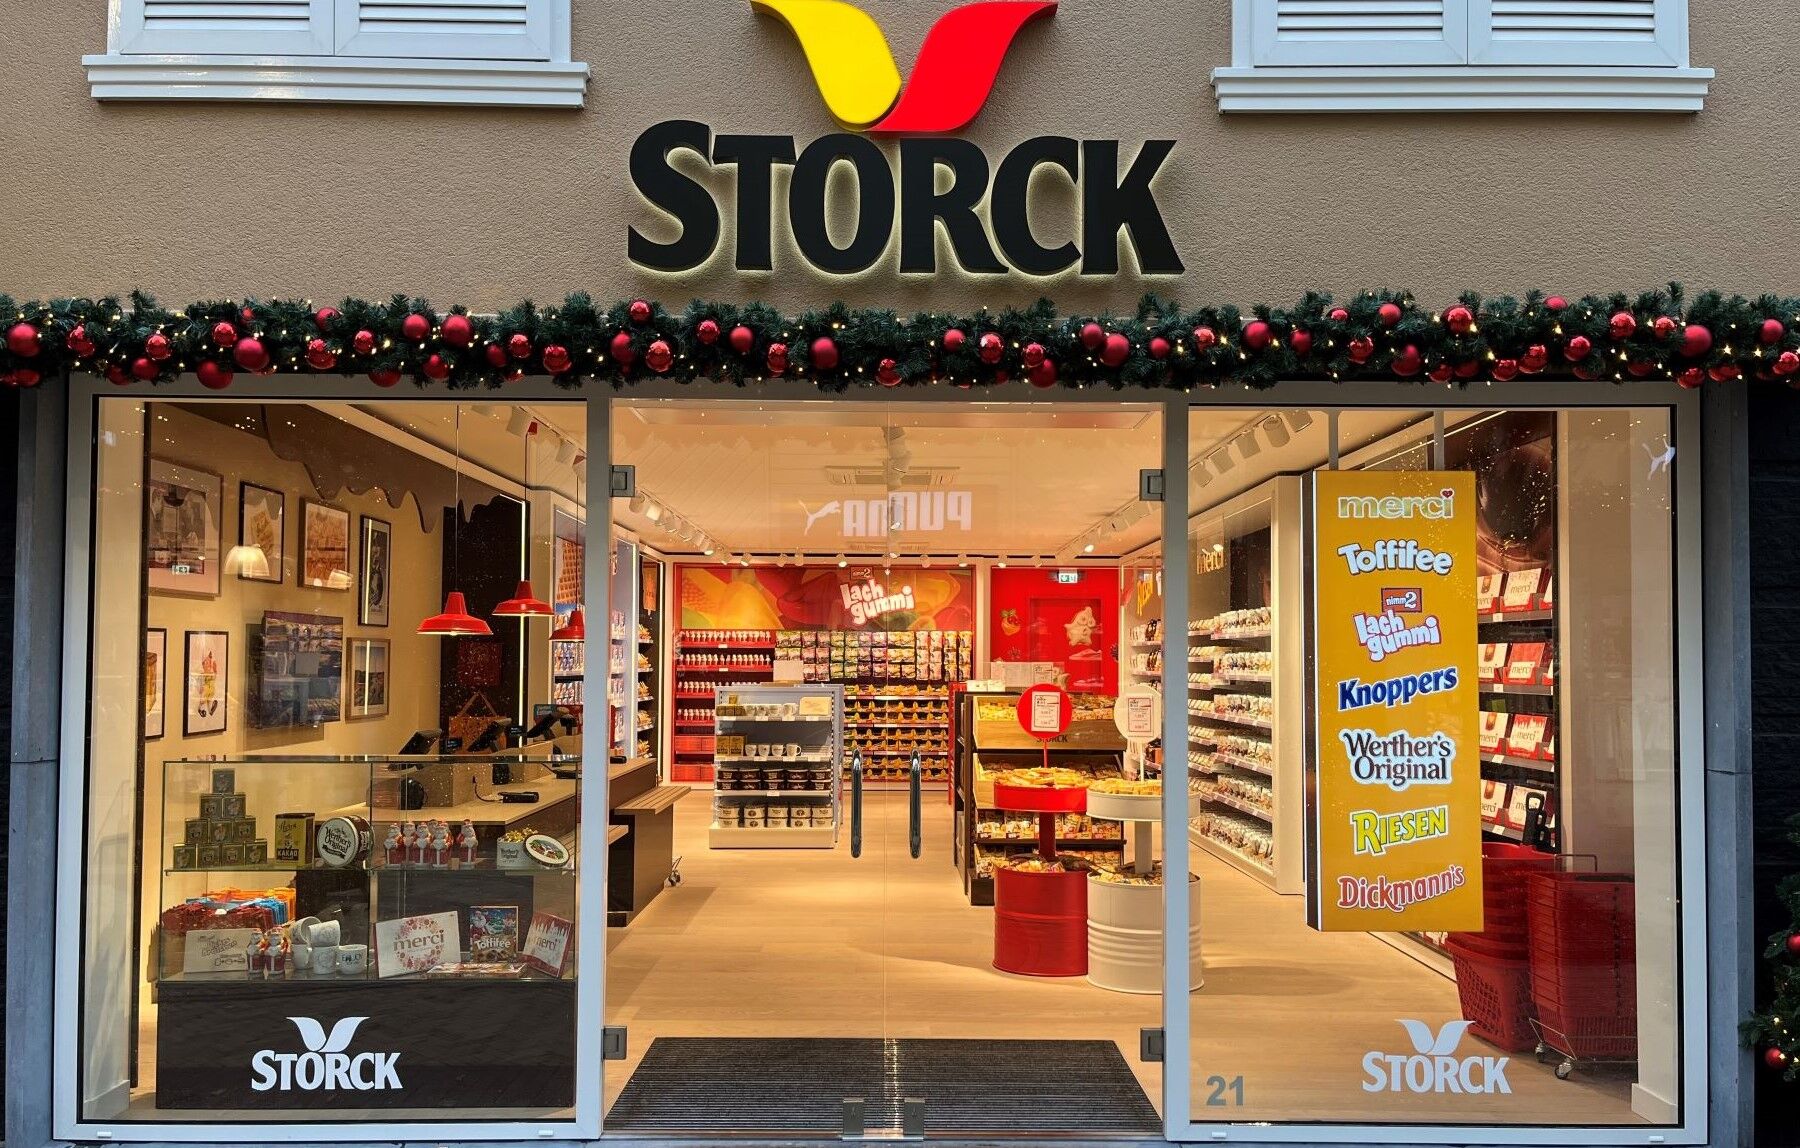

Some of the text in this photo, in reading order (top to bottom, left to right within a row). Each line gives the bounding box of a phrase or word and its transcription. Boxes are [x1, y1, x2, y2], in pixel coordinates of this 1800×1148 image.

[628, 120, 1185, 274] STORCK
[1338, 488, 1454, 518] merci
[1338, 540, 1453, 575] Toffifee
[851, 585, 914, 624] gummi
[1367, 616, 1440, 661] gummi
[1339, 667, 1457, 711] Knoppers
[1343, 732, 1451, 758] Werther's
[1354, 755, 1447, 787] Original
[1352, 806, 1447, 854] RIESEN
[1338, 865, 1464, 911] Dickmann's
[394, 929, 444, 951] merci
[474, 939, 511, 949] Toffifee
[251, 1050, 403, 1091] STORCK
[1362, 1051, 1512, 1094] STORCK
[1206, 1075, 1244, 1106] 21
